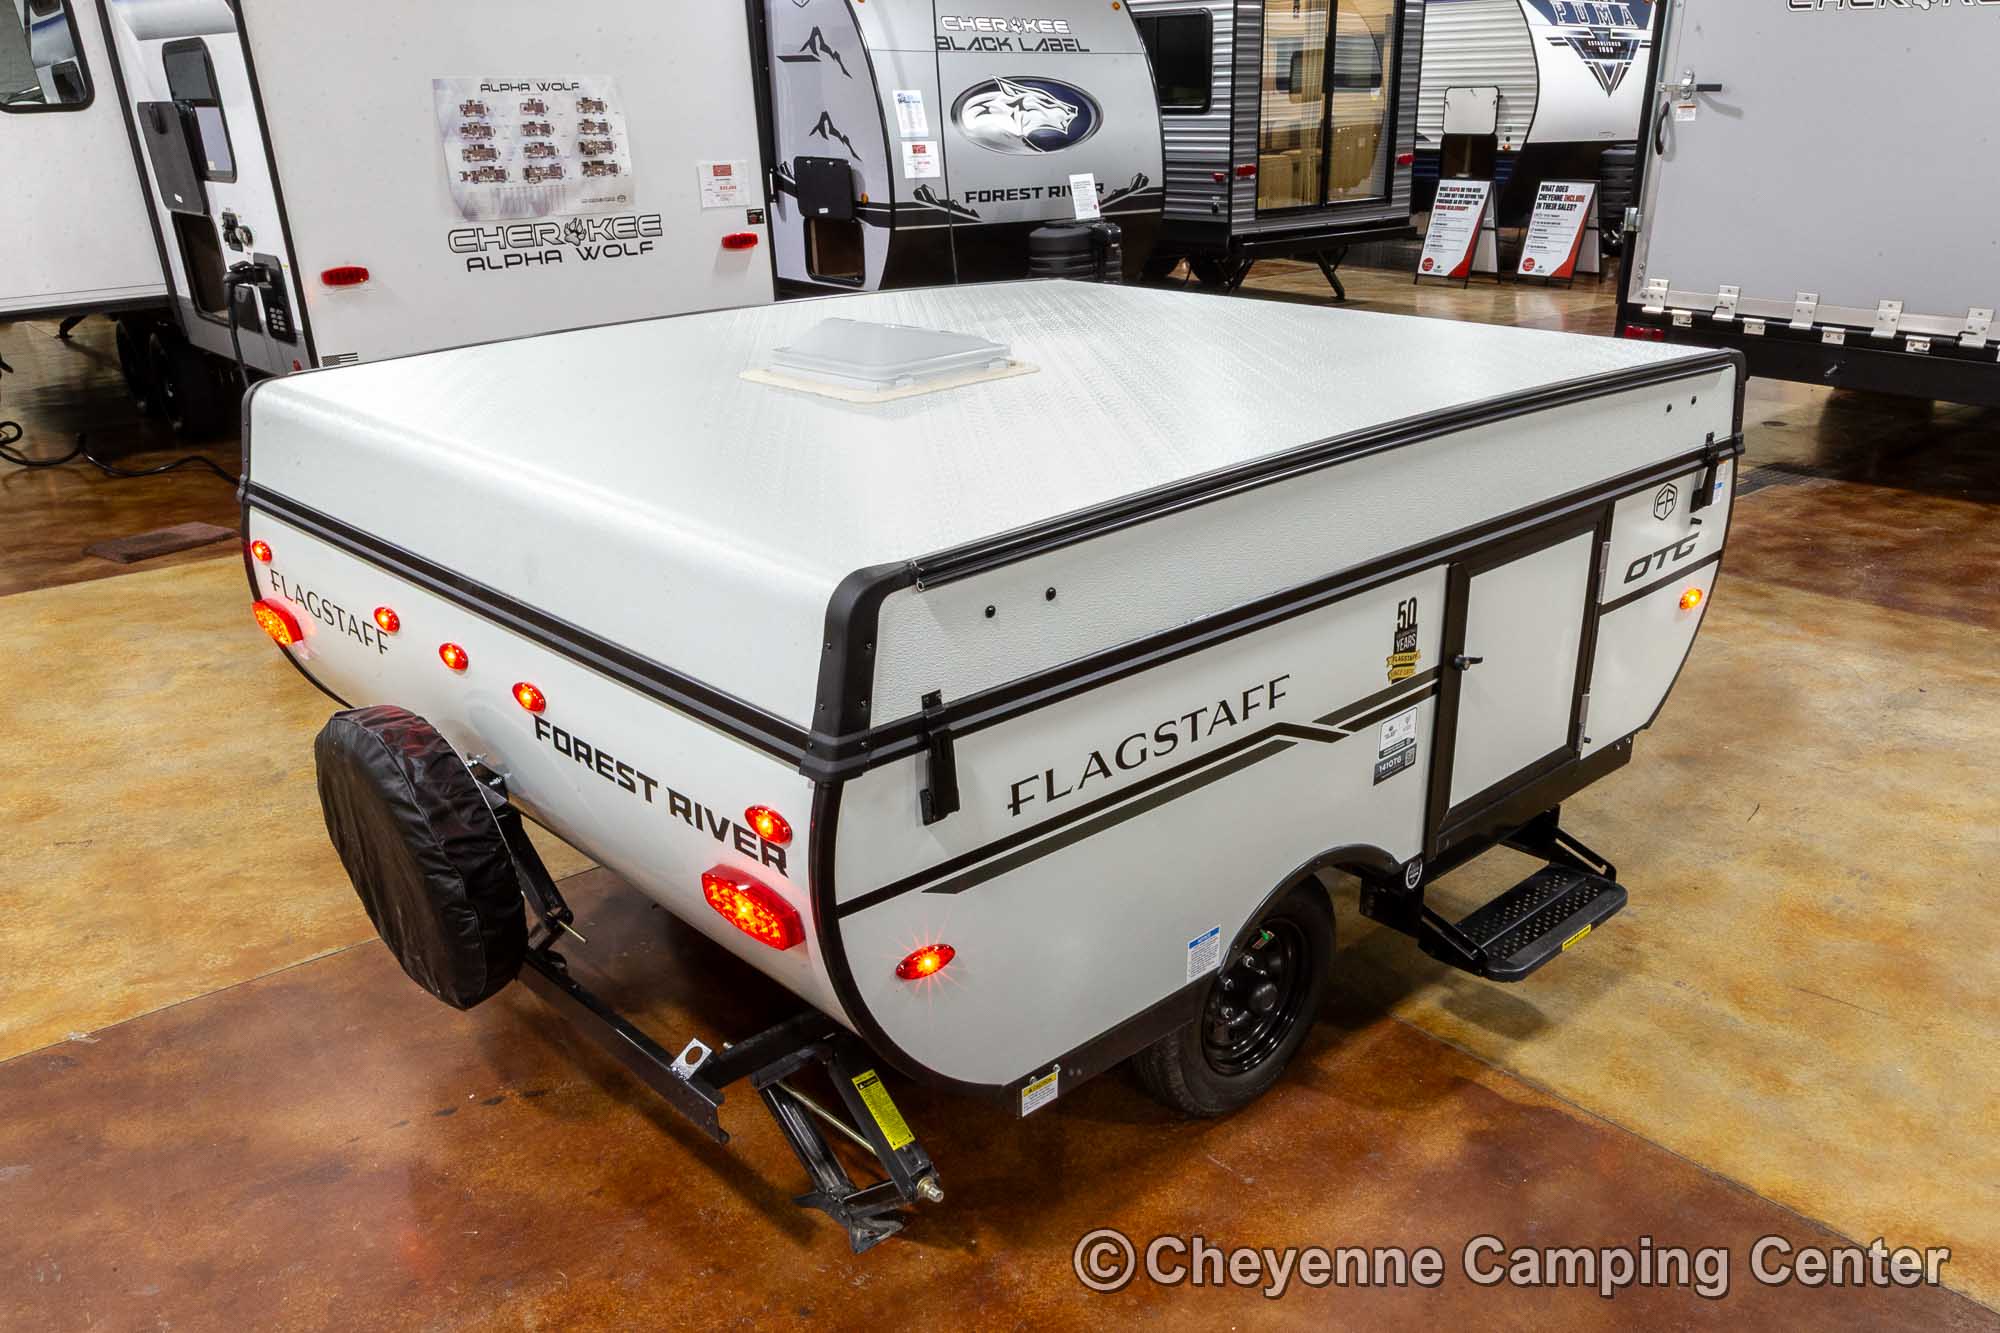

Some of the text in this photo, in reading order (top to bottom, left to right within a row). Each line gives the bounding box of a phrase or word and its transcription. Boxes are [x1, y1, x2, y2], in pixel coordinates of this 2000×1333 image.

[1551, 0, 1639, 28] PUMA
[936, 36, 1090, 52] BLACK LABEL
[480, 82, 580, 93] ALPHA WOLF
[965, 187, 1043, 203] FOREST
[1538, 194, 1585, 203] CHEYENNE INCLUDE
[1555, 185, 1569, 193] DOES
[1543, 202, 1557, 210] THEIR
[1558, 203, 1577, 212] SALES?
[466, 240, 654, 272] ALPHA WOLF
[1623, 532, 1700, 584] OTG
[270, 568, 389, 655] FLAGSTAFF
[1397, 597, 1417, 631] 50
[1396, 633, 1416, 652] YEARS
[1007, 674, 1290, 817] FLAGSTAFF
[533, 714, 789, 878] FOREST RIVER
